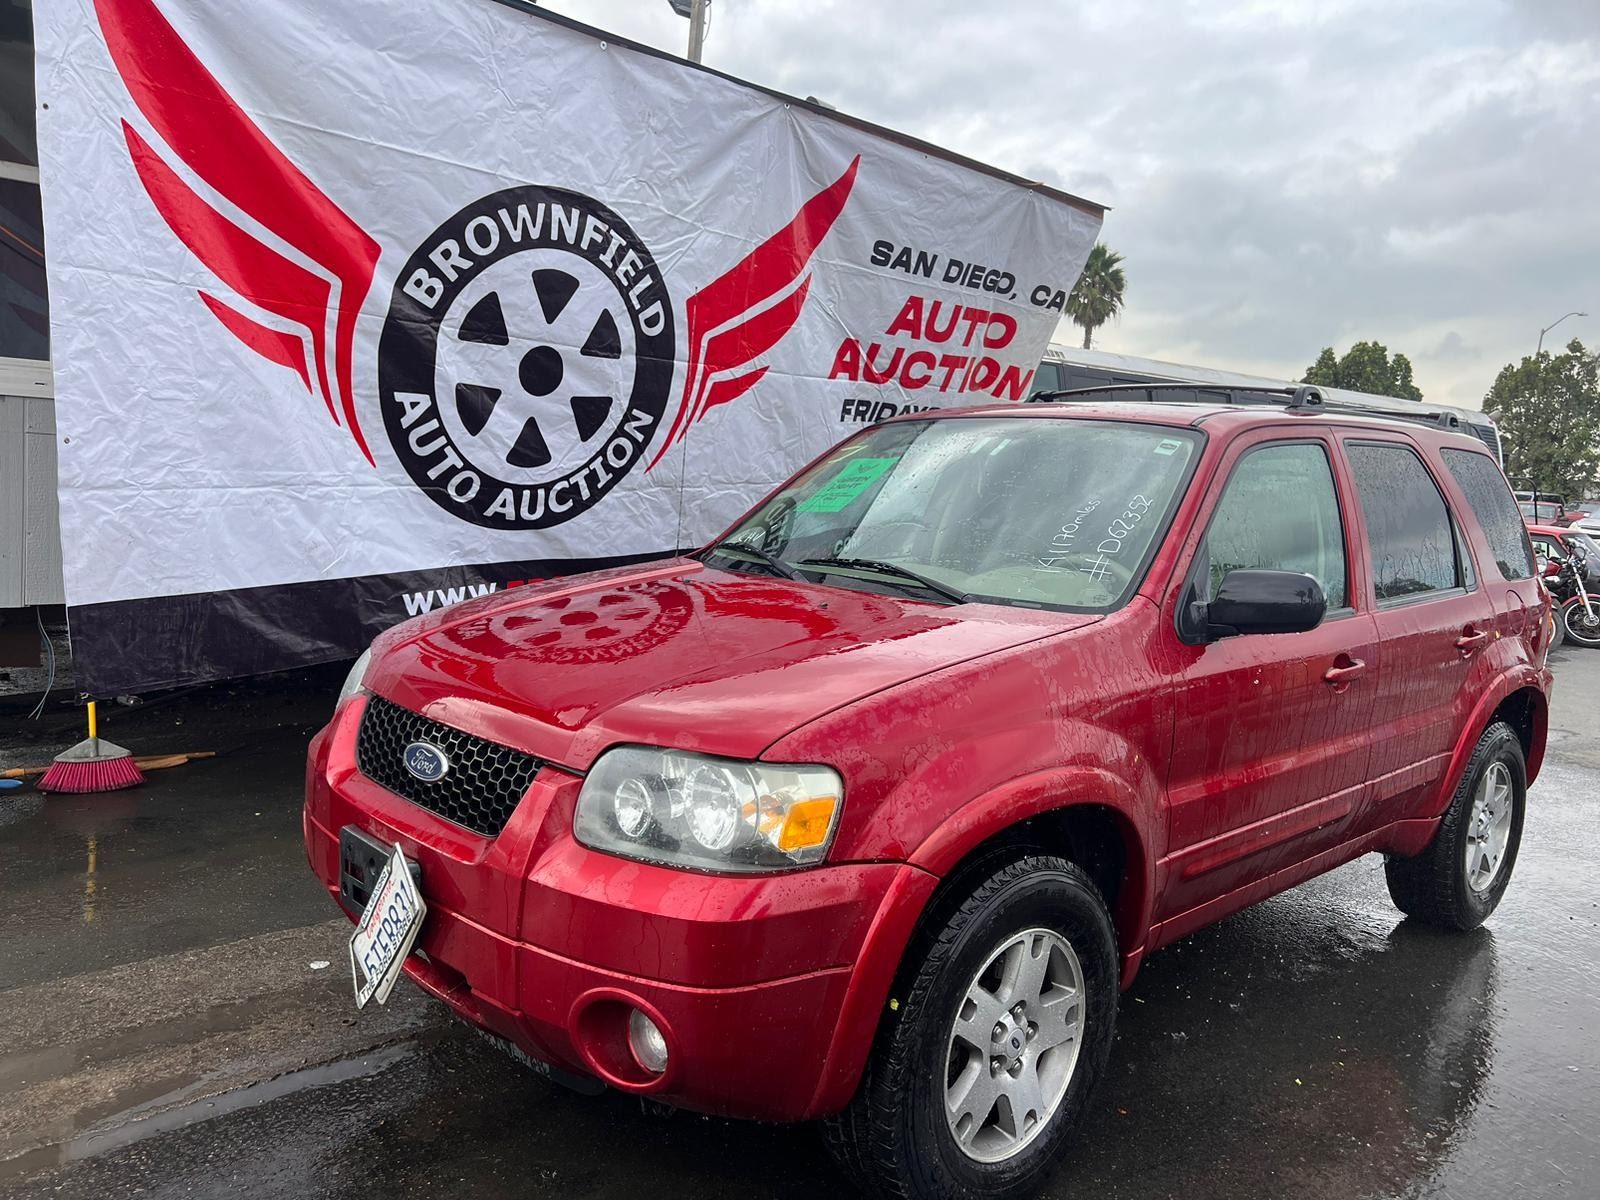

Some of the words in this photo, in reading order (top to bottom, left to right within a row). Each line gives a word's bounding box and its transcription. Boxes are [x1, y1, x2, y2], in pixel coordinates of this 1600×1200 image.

[402, 203, 665, 337] BROWNFIELD
[870, 240, 937, 277] SAN
[942, 259, 1017, 300] DIEGO,
[1030, 284, 1066, 312] CA
[885, 296, 1017, 349] AUTO
[828, 338, 1034, 401] AUCTION
[394, 391, 480, 503] AUTO
[485, 407, 653, 521] AUCTION
